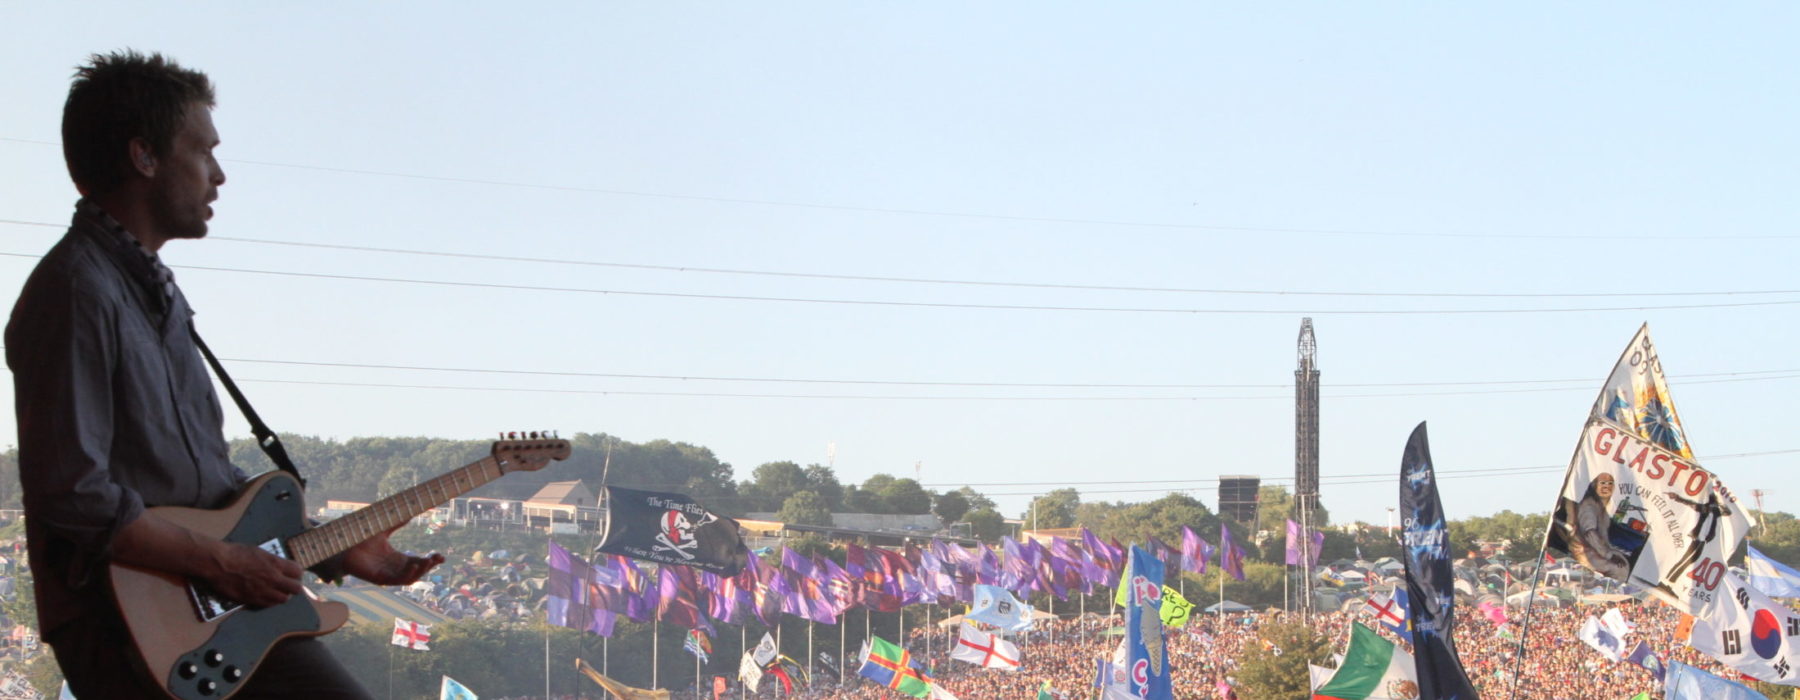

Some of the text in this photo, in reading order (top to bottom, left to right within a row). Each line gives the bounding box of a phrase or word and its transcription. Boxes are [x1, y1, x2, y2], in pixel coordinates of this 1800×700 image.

[1594, 428, 1709, 496] GLASTO
[1618, 483, 1634, 495] YOU
[1635, 485, 1652, 499] CAN
[647, 496, 704, 515] The Time Flies
[1662, 509, 1675, 519] IT
[1667, 519, 1680, 533] ALL
[1686, 557, 1726, 591] 40
[1682, 584, 1712, 602] YEARS
